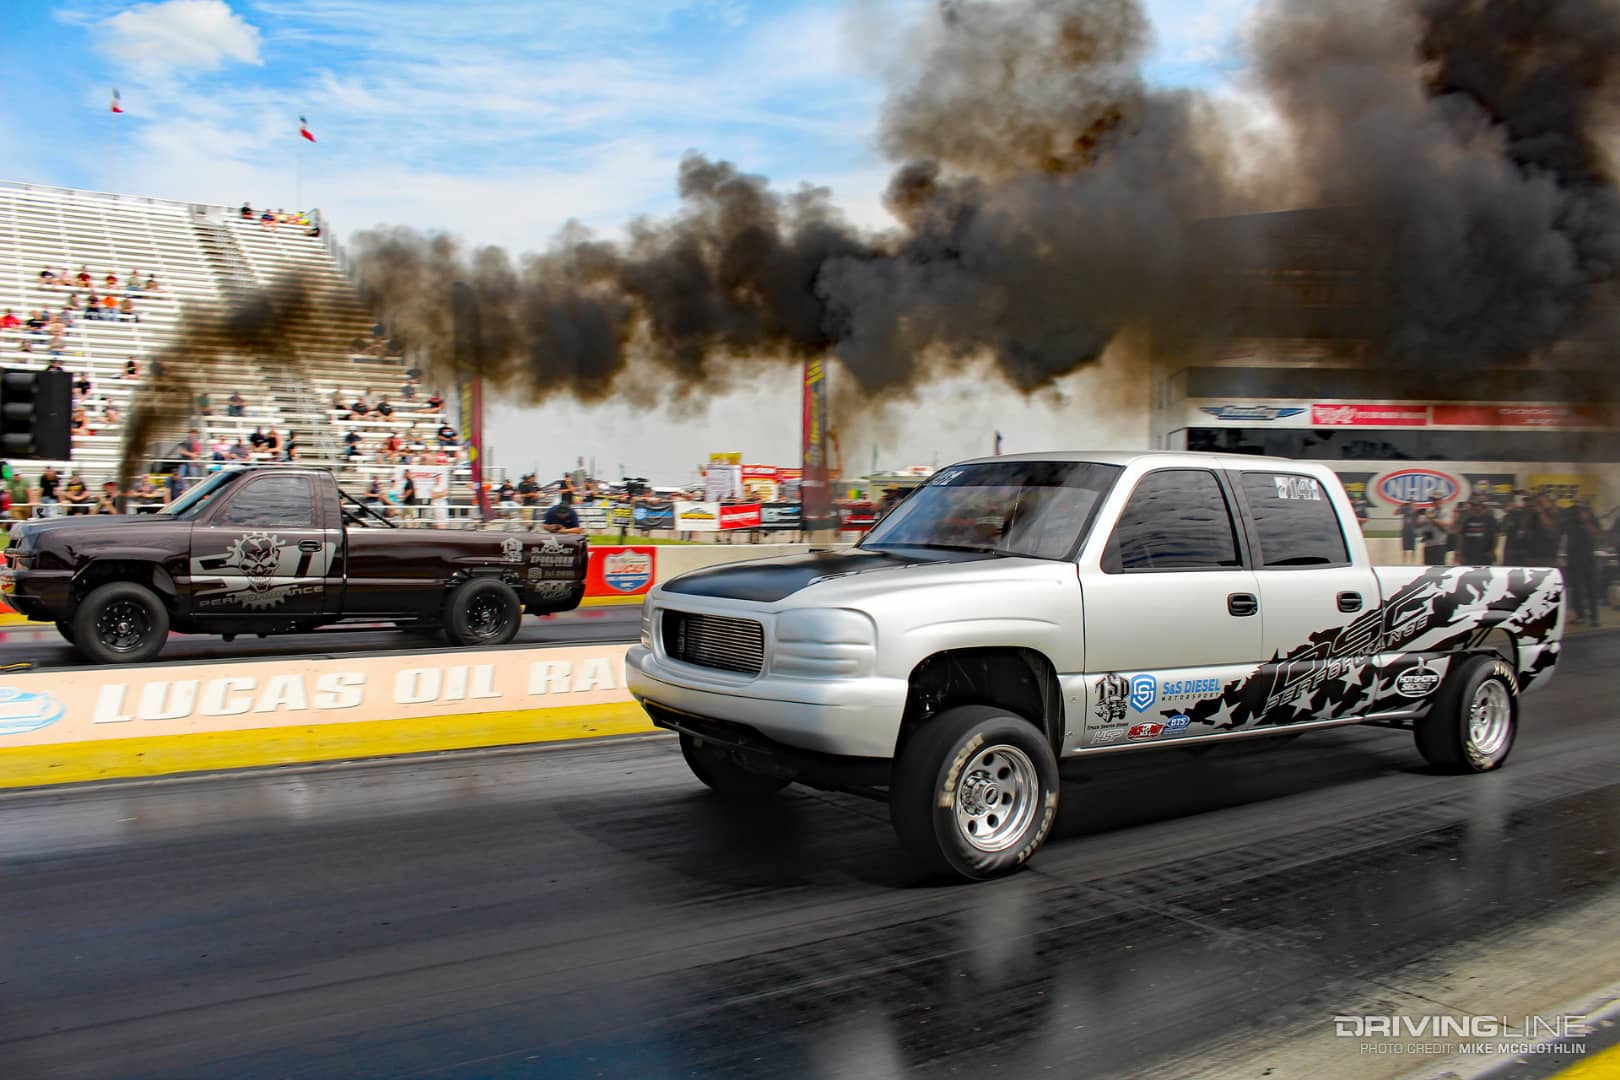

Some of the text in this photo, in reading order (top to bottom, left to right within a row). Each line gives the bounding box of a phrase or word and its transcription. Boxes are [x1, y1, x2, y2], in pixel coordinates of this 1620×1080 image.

[92, 671, 367, 724] LUCAS
[394, 664, 503, 704] OIL
[1163, 679, 1220, 695] S&S DIESEL
